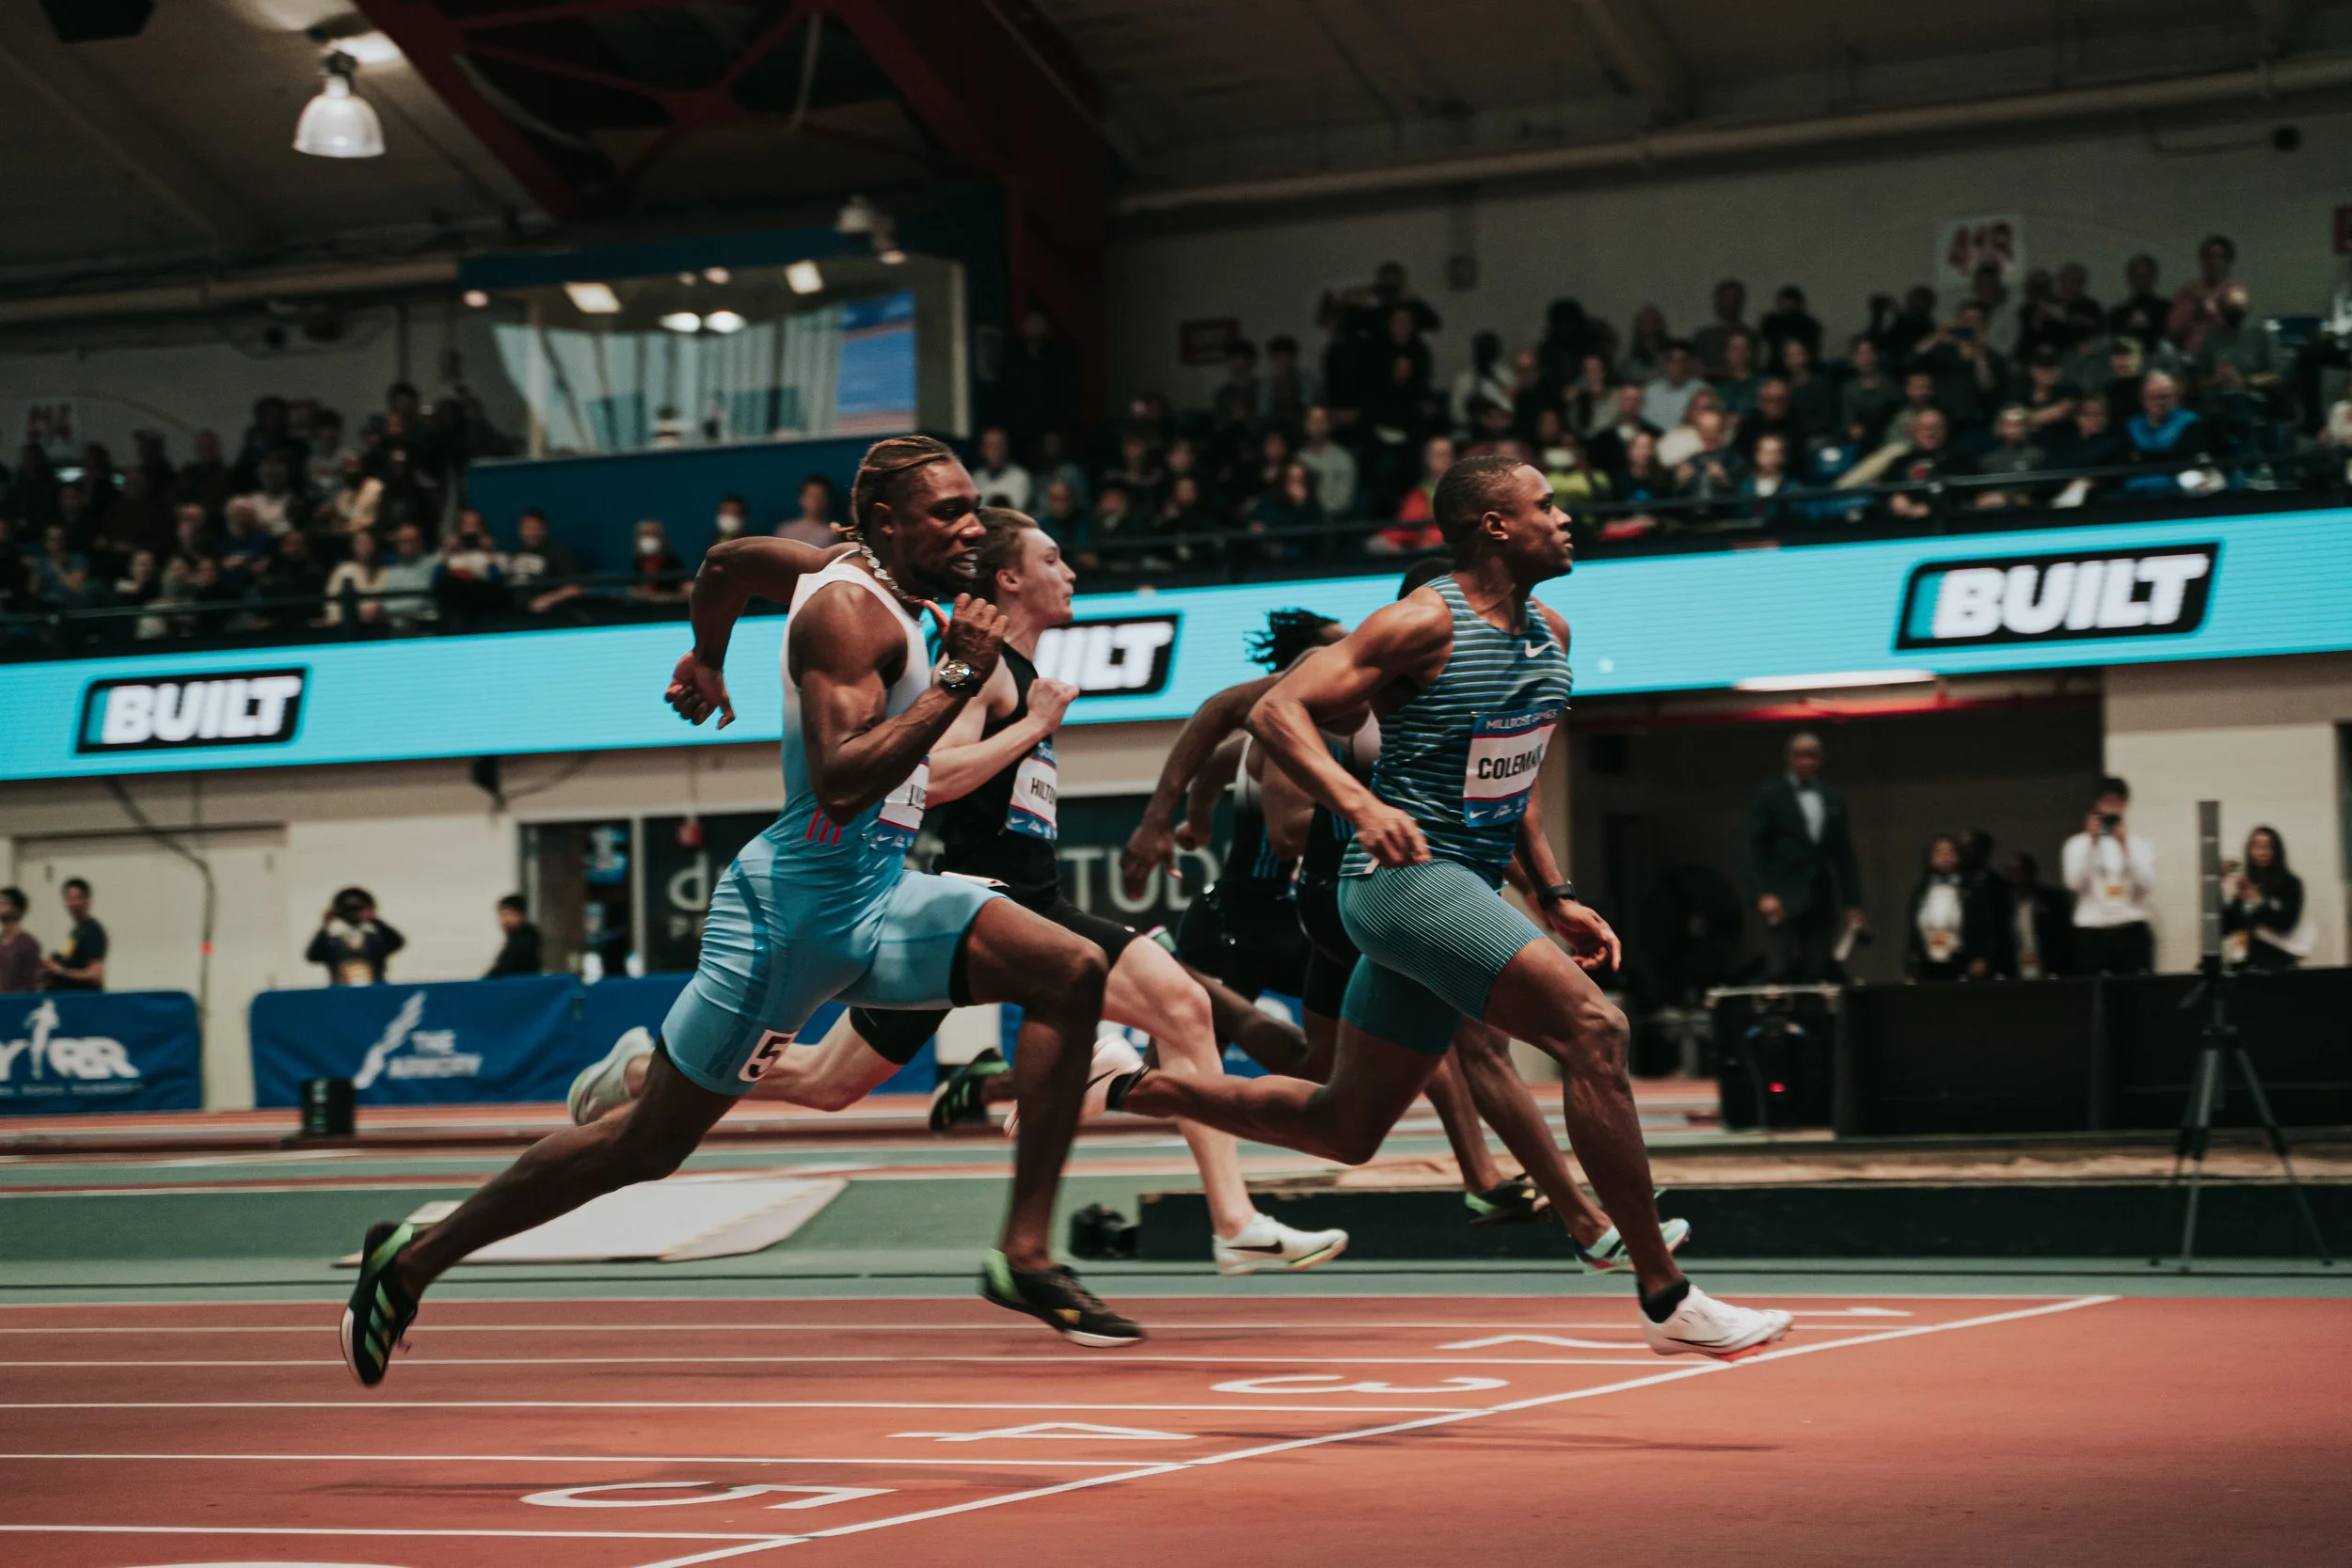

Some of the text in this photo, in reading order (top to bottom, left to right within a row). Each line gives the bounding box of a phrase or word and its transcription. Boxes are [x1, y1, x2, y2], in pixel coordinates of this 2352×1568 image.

[1932, 552, 2210, 640] BUILT
[1034, 621, 1175, 691] ILT
[101, 675, 302, 744] BUILT
[1030, 777, 1057, 806] HILTO
[748, 1036, 791, 1078] 5
[1208, 1374, 1511, 1395] 3
[886, 1420, 1199, 1442] 4
[520, 1481, 898, 1510] 5
